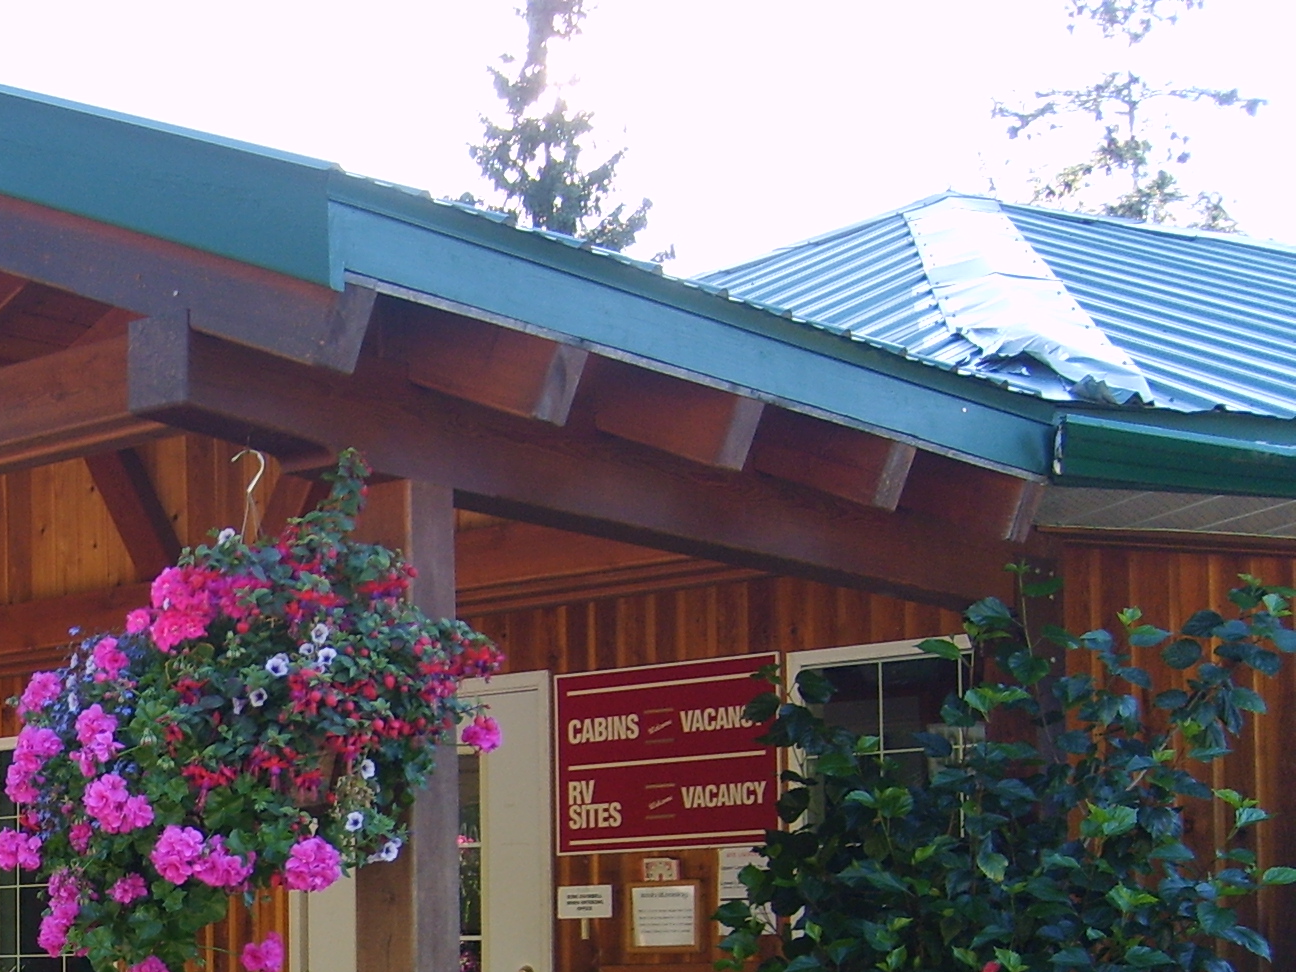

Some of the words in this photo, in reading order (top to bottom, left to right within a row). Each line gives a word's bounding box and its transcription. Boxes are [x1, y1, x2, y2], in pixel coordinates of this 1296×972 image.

[567, 713, 640, 745] CABINS
[679, 704, 763, 733] VACANC
[568, 779, 595, 805] RV
[681, 780, 767, 809] VACANCY
[568, 802, 623, 830] SITES
